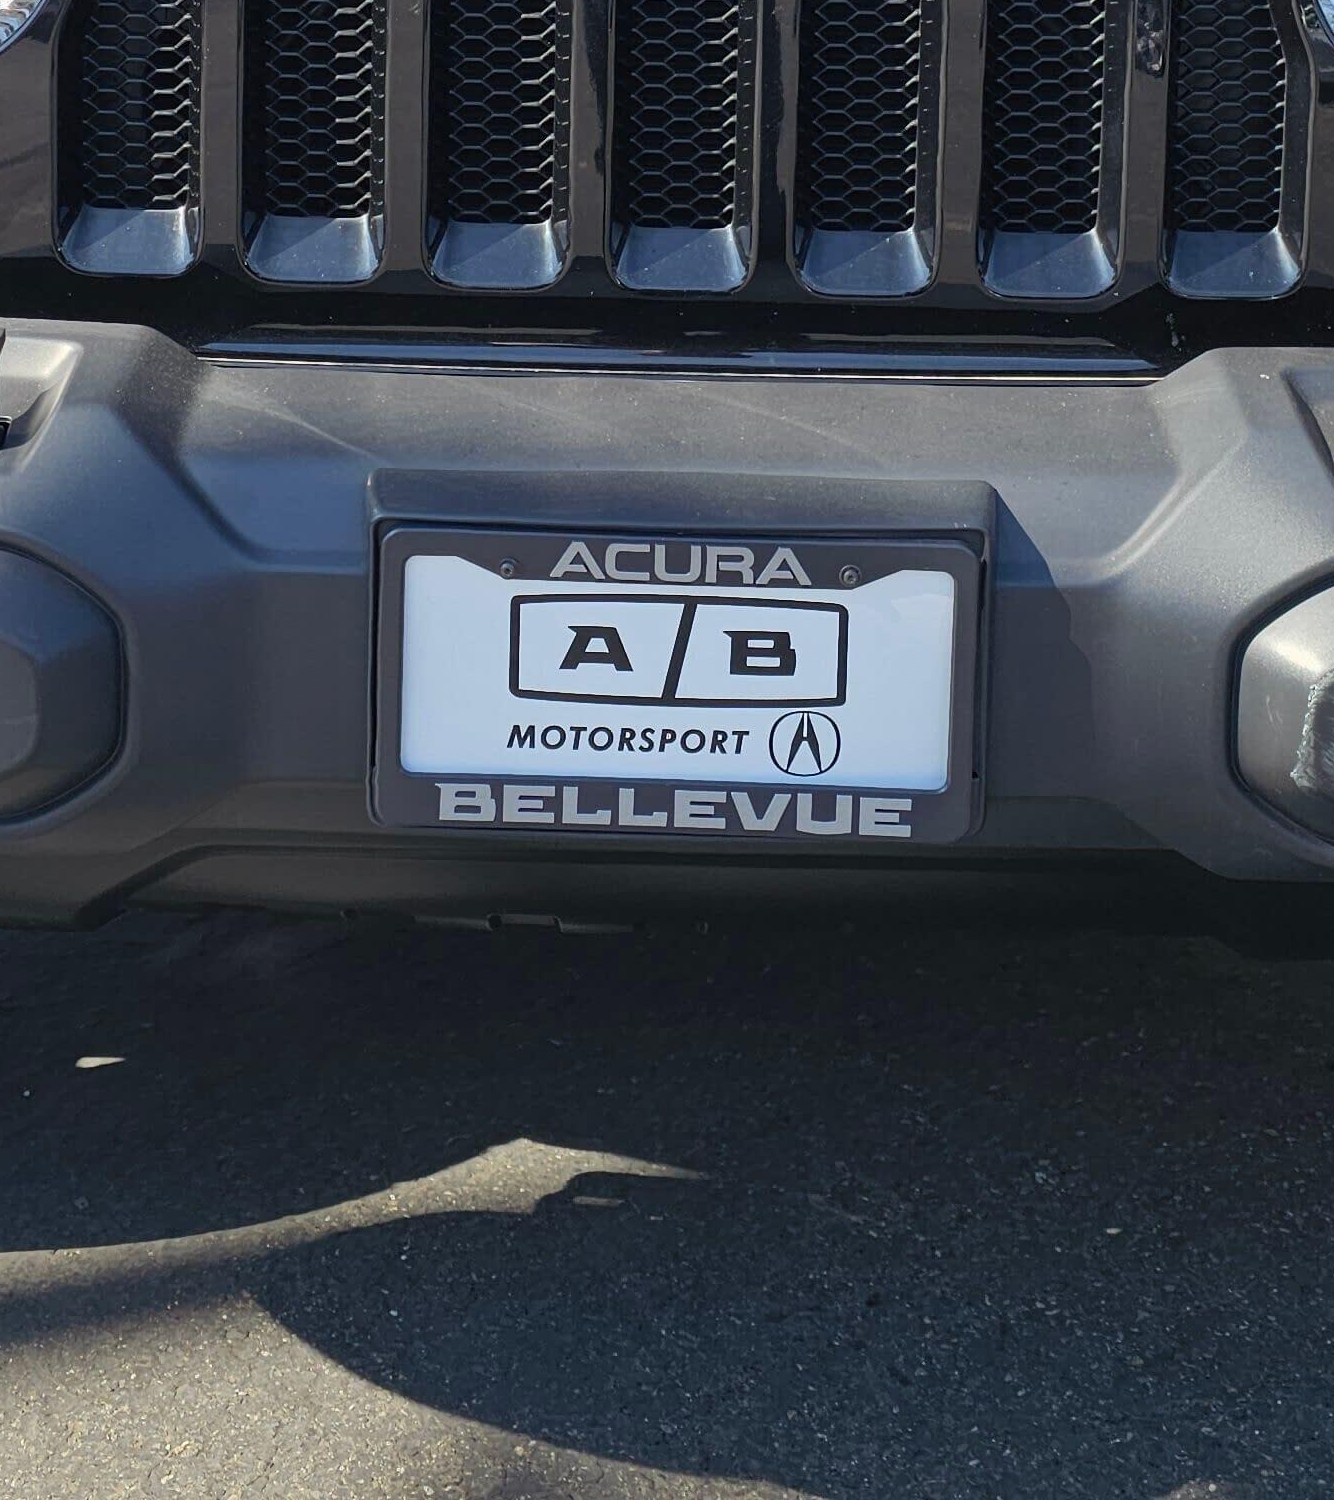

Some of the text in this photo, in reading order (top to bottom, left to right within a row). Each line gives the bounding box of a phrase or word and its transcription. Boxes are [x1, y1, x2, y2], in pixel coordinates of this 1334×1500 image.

[549, 540, 812, 586] ACURA
[506, 723, 750, 755] MOTORSPORT
[435, 782, 912, 838] BELLEVUE
